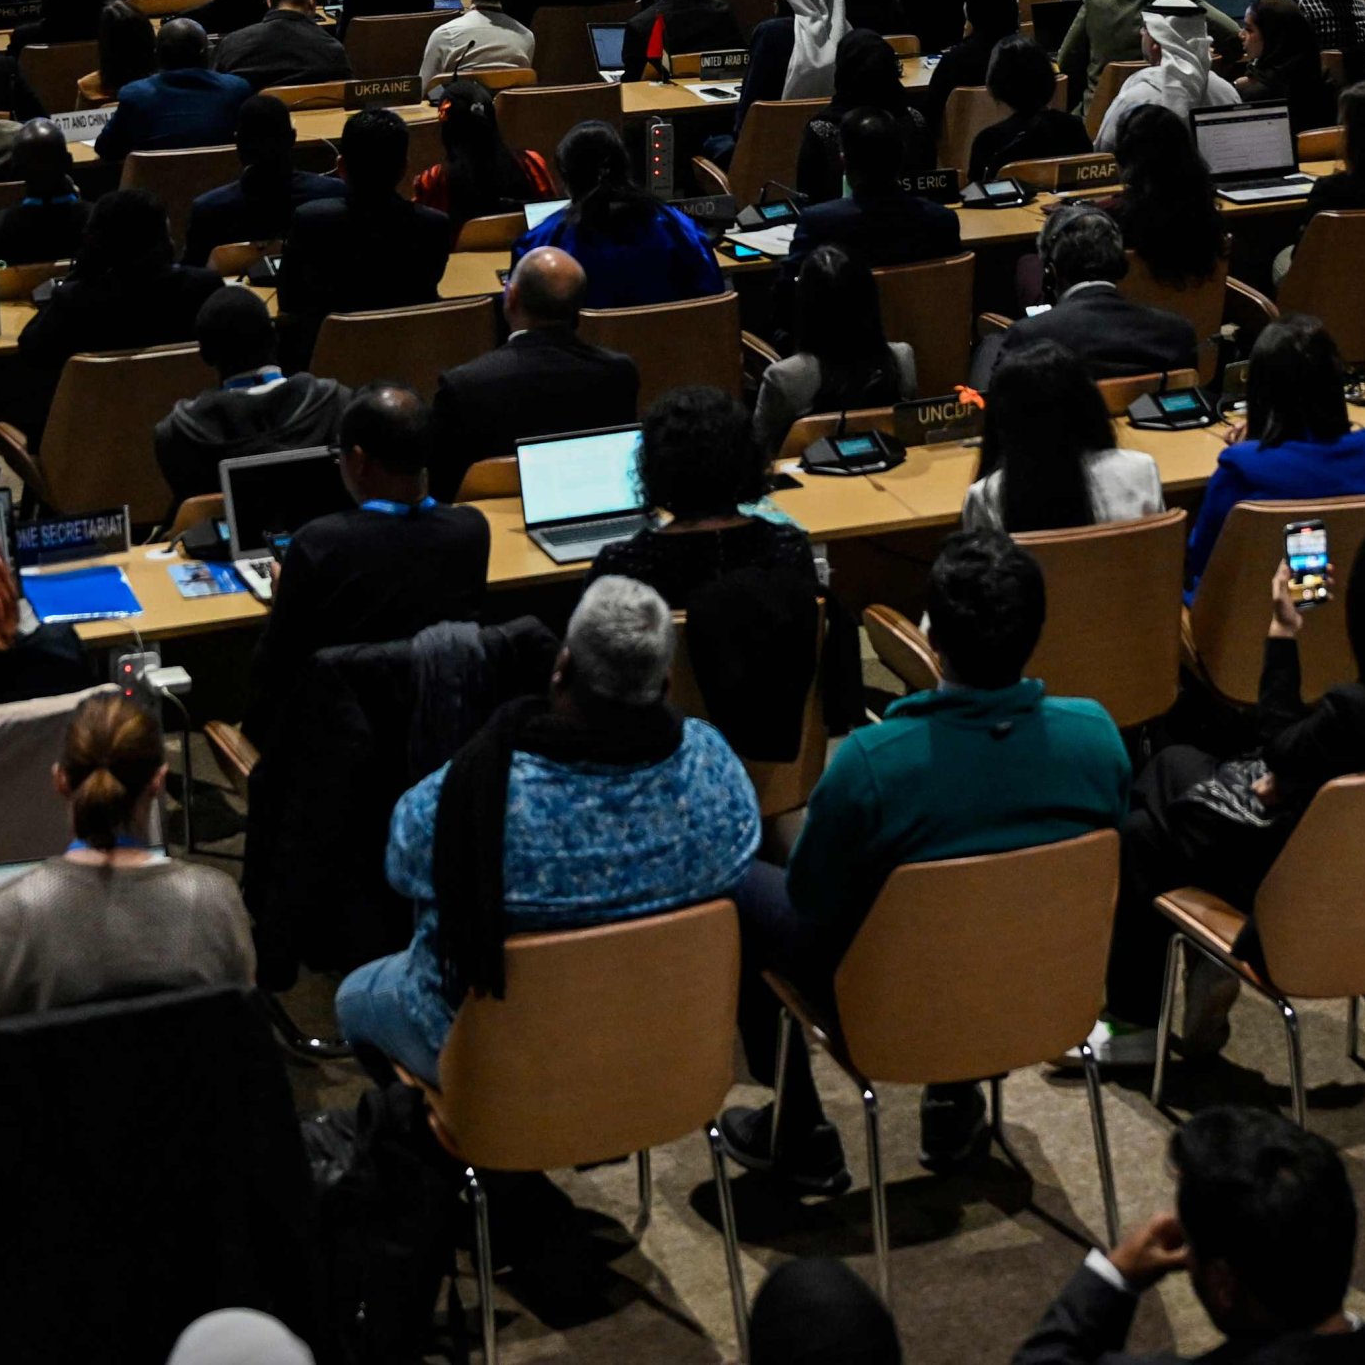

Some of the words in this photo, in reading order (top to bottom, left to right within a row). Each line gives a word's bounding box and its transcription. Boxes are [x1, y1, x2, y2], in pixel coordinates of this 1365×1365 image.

[700, 55, 722, 69] UNITED
[724, 53, 742, 67] ARAB
[354, 80, 412, 98] UKRAINE
[72, 115, 87, 129] AND
[1076, 163, 1117, 181] ICRAF
[917, 174, 948, 191] ERIC
[41, 515, 125, 546] SECRETARIAT
